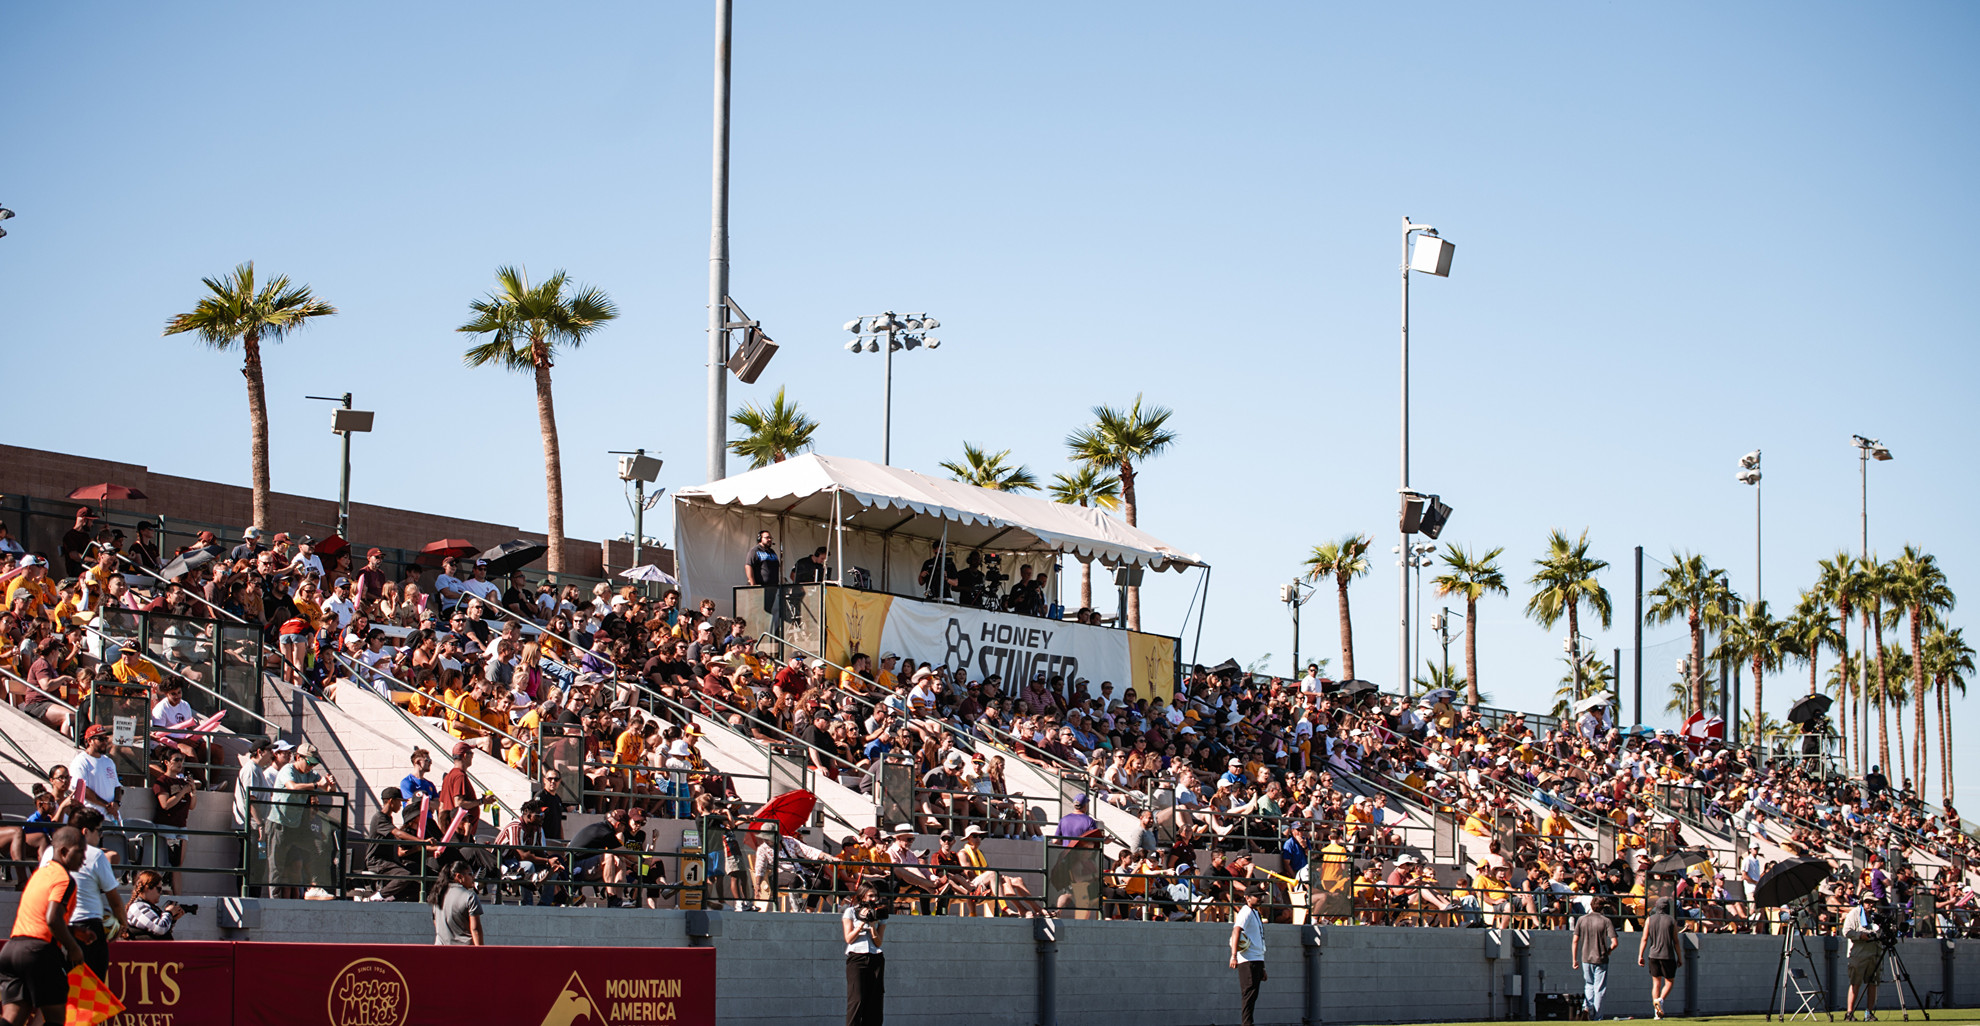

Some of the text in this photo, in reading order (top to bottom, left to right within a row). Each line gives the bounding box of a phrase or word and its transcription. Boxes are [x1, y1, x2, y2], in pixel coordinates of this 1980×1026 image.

[981, 622, 1054, 649] HONEY
[339, 973, 400, 1008] Jersey
[606, 979, 682, 999] MOUNTAIN
[610, 1001, 677, 1021] AMERICA
